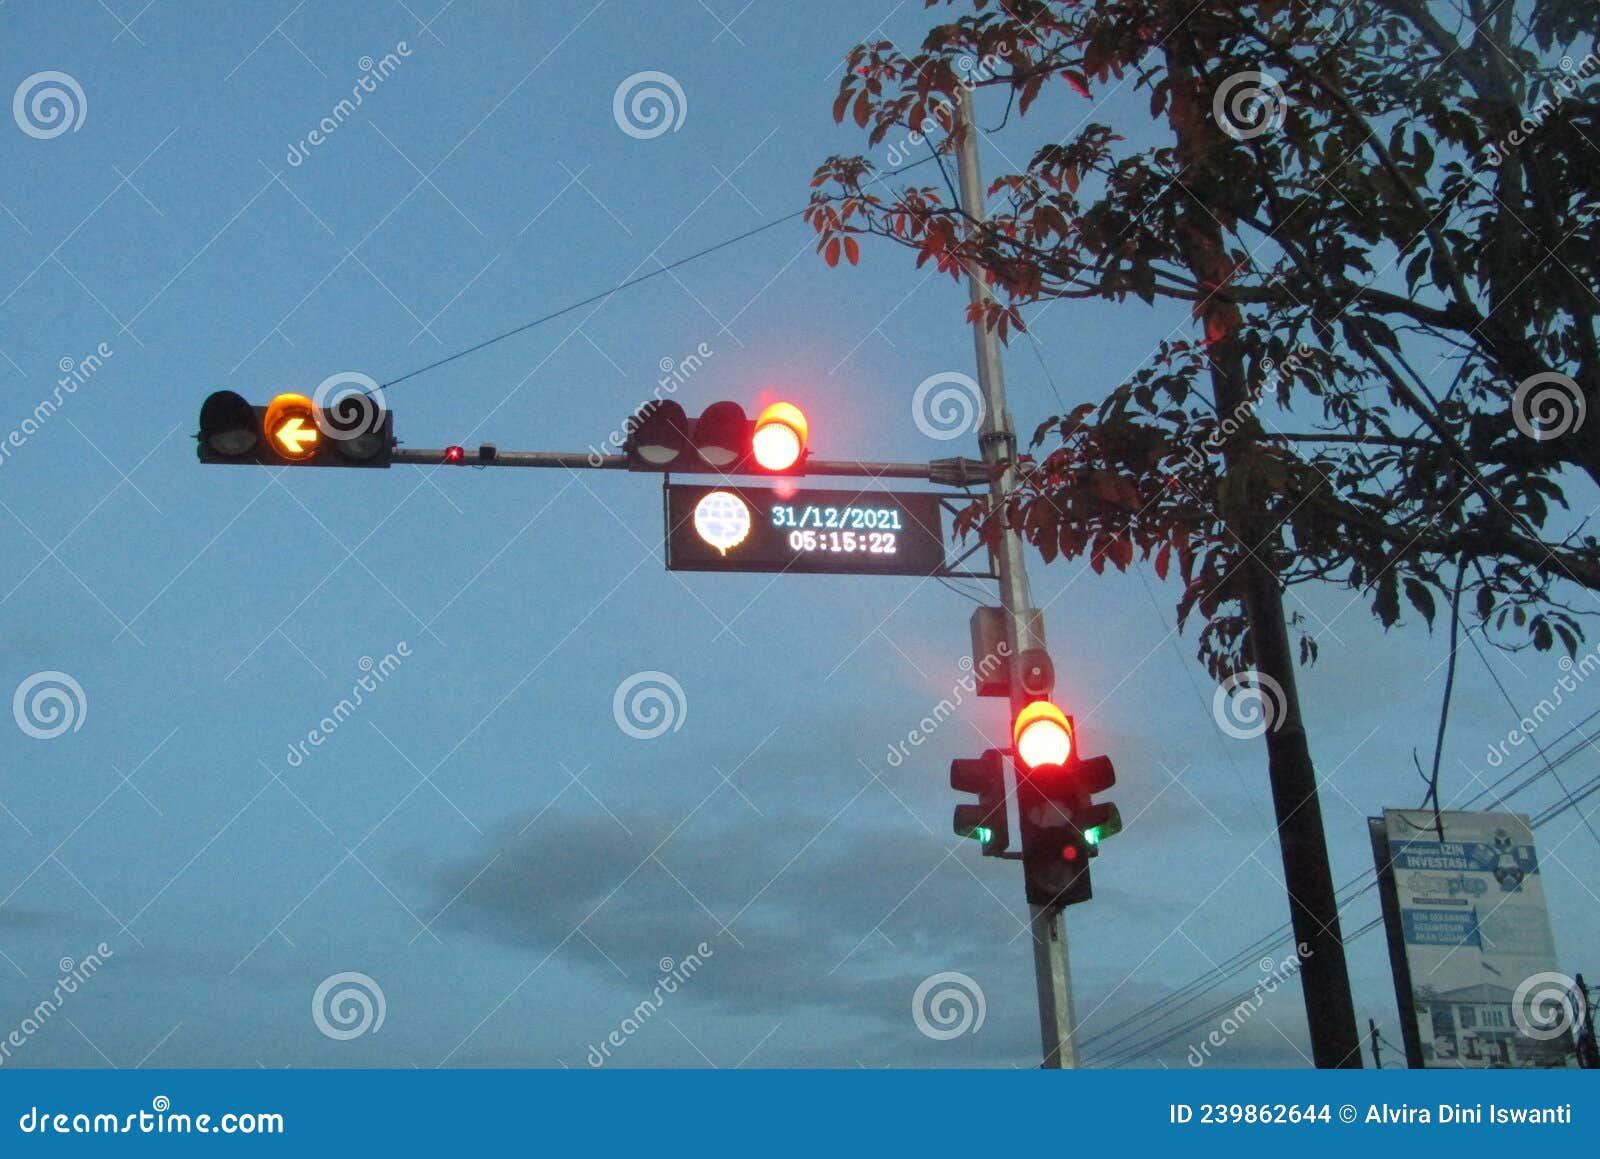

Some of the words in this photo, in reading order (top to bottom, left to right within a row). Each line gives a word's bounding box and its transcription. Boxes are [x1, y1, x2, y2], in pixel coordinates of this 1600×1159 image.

[772, 506, 901, 529] 31/12/2021
[790, 531, 896, 553] 05:15:22
[1440, 843, 1464, 855] IZIN
[1407, 856, 1467, 869] INVESTASI
